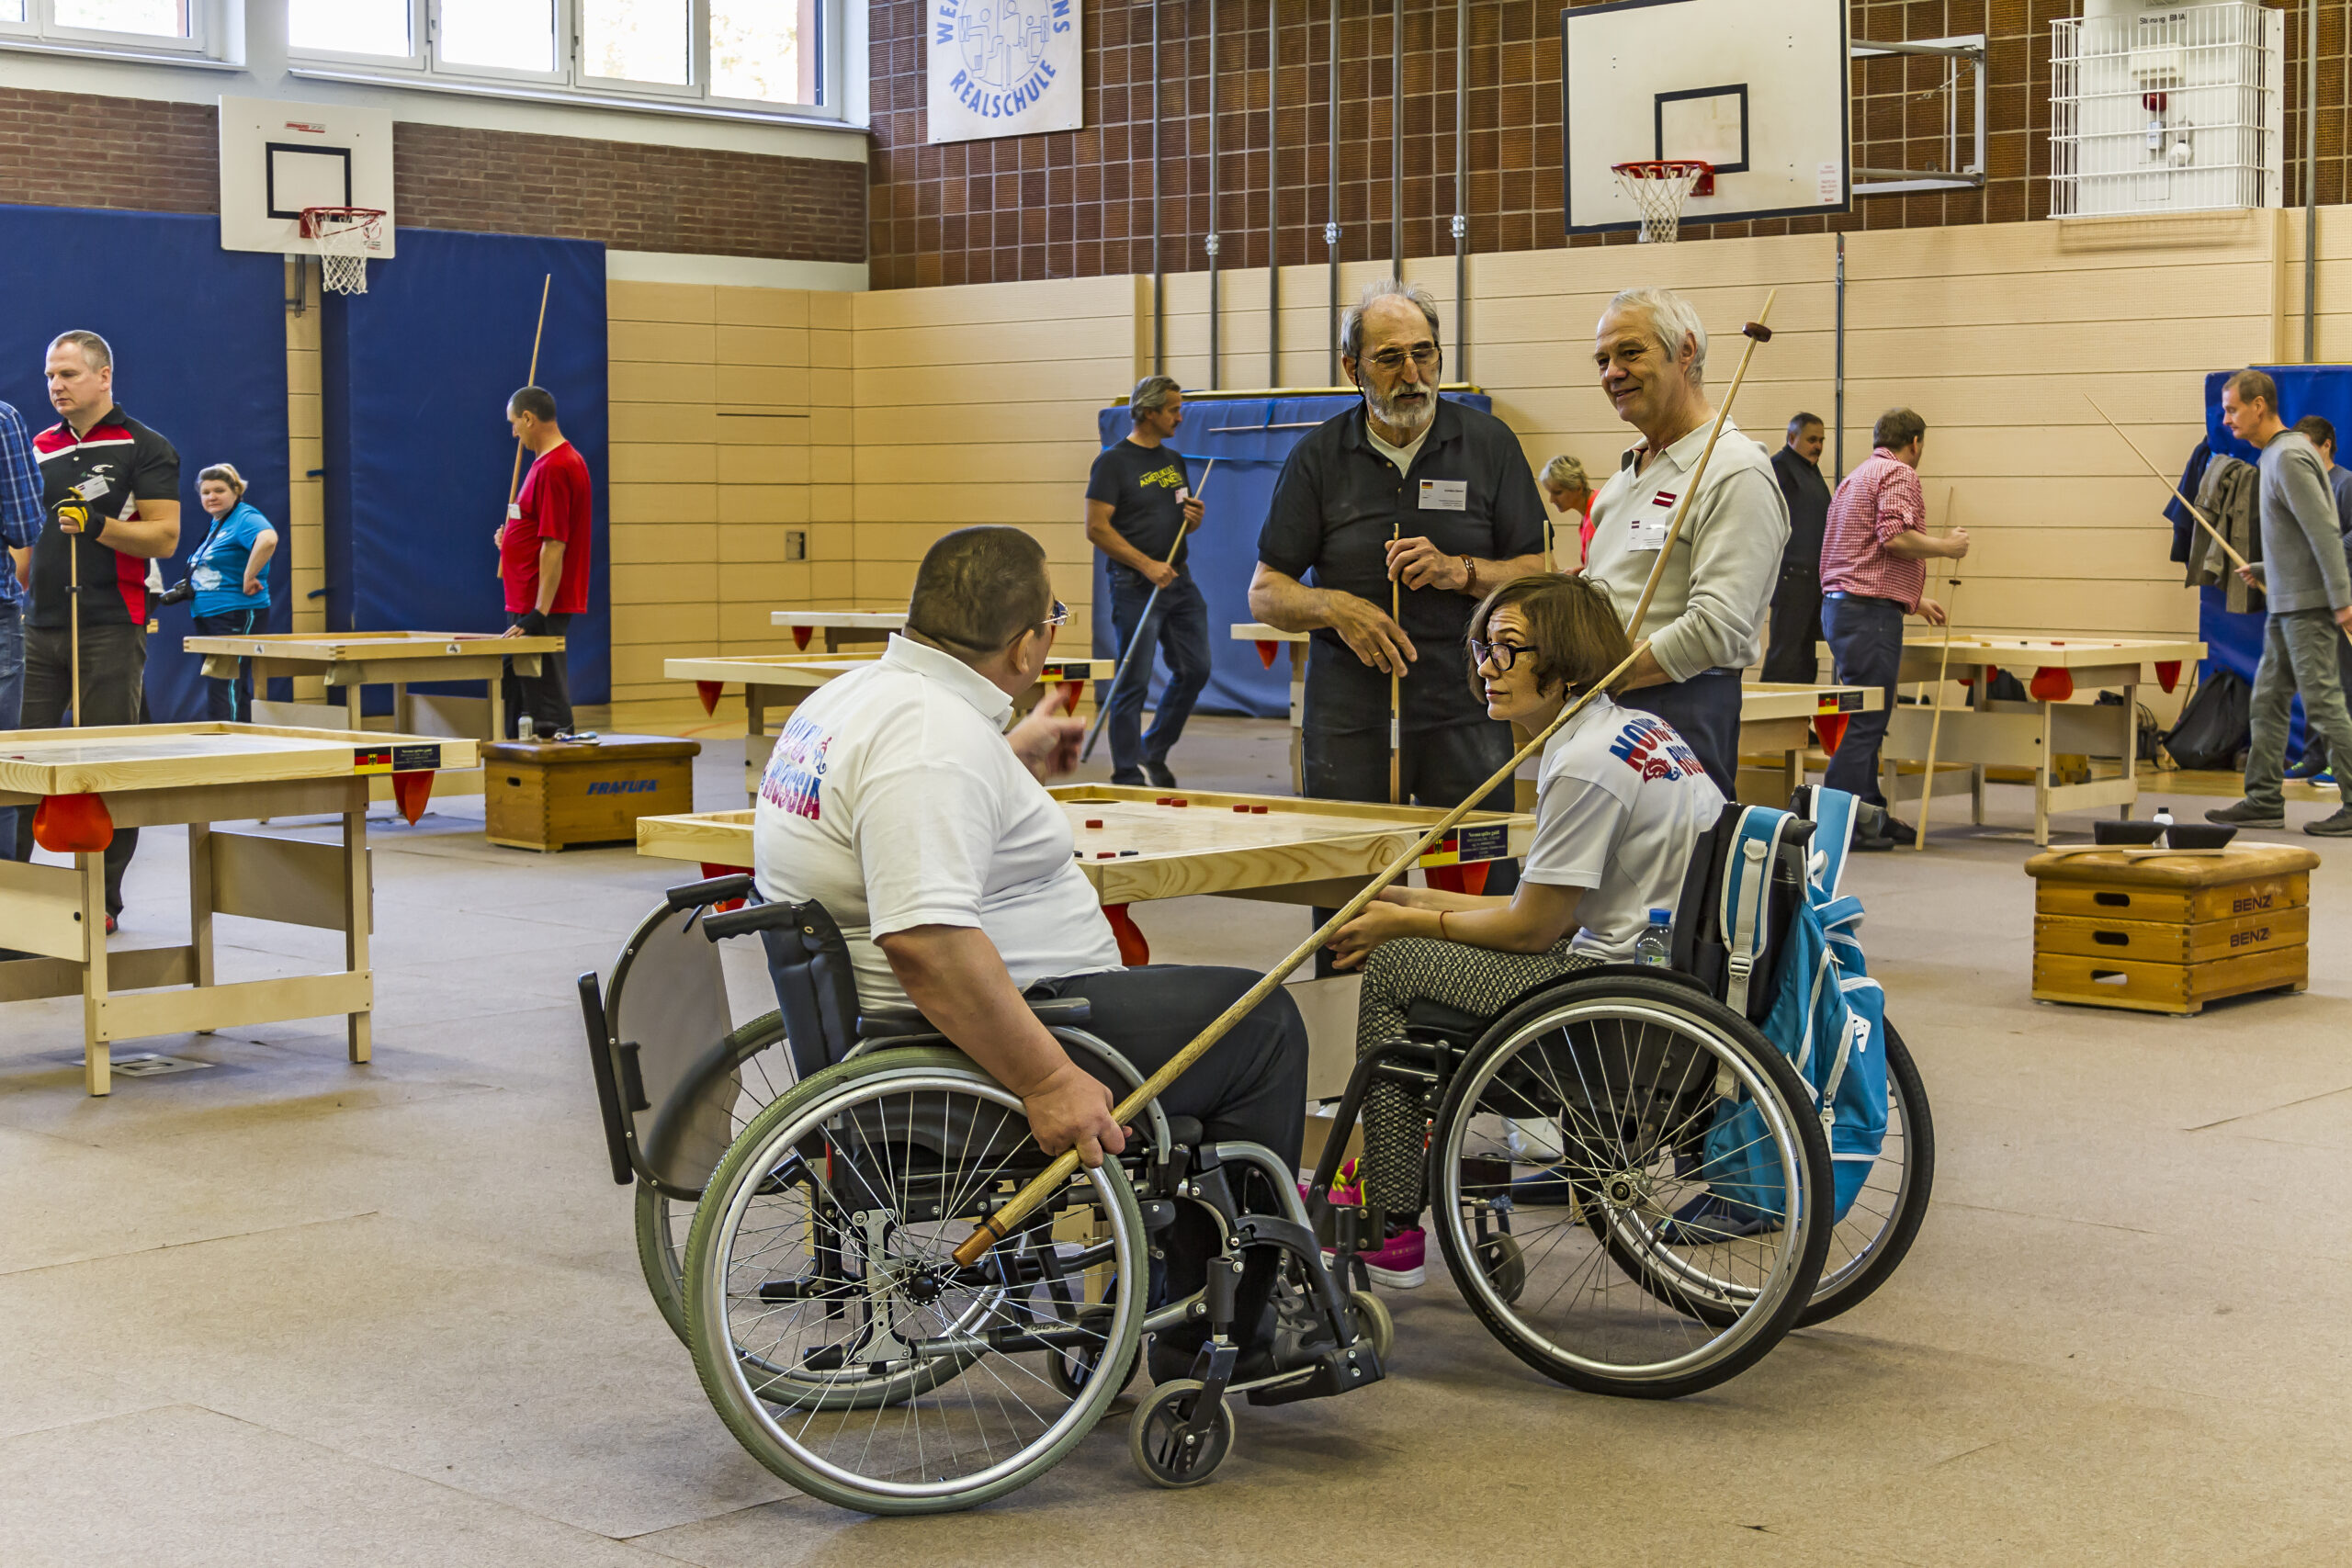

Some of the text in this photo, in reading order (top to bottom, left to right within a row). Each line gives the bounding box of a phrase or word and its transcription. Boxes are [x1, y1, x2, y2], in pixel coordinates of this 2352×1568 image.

[1051, 0, 1070, 33] NS
[949, 59, 1057, 118] REALSCHULE
[586, 779, 658, 795] FRATUFA
[762, 757, 822, 820] RUSSIA
[2233, 894, 2272, 913] BENZ
[2230, 927, 2269, 948] BENZ
